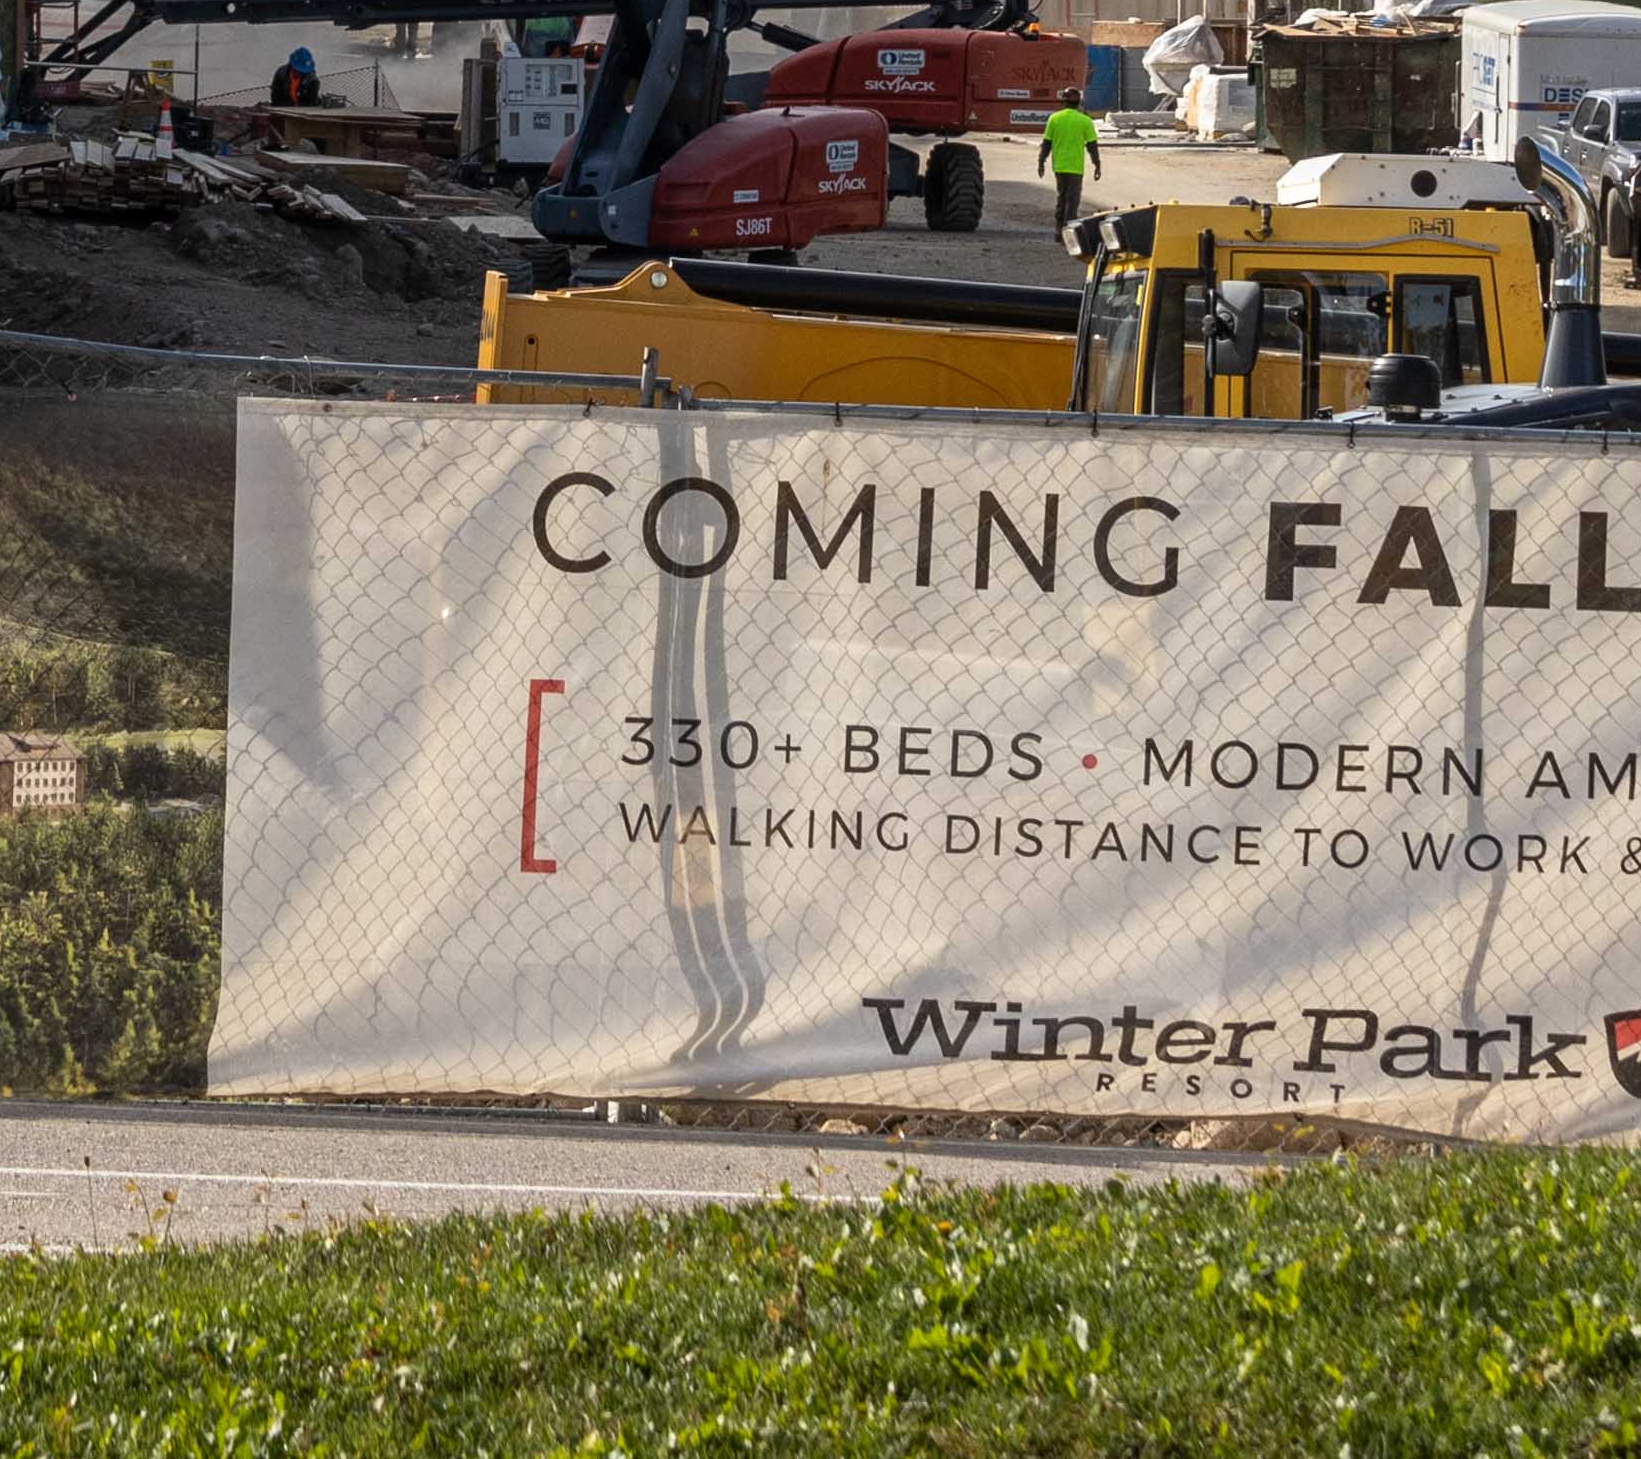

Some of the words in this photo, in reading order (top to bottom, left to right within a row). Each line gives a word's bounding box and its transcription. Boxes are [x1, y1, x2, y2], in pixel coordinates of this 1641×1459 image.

[865, 76, 936, 93] SKYJACK
[818, 174, 867, 194] SKYJACK
[736, 217, 773, 236] SJ86T
[532, 472, 1182, 598] COMING
[621, 716, 803, 768] 330+
[843, 723, 1045, 781] BEDS
[1143, 737, 1486, 796] MODERN
[618, 800, 912, 853] WALKING
[945, 814, 1262, 866] DISTANCE
[1294, 826, 1370, 869] TO
[1401, 830, 1591, 875] WORK
[862, 997, 1277, 1072] Winter
[1296, 1007, 1589, 1082] Park
[1096, 1072, 1344, 1103] RESORT
